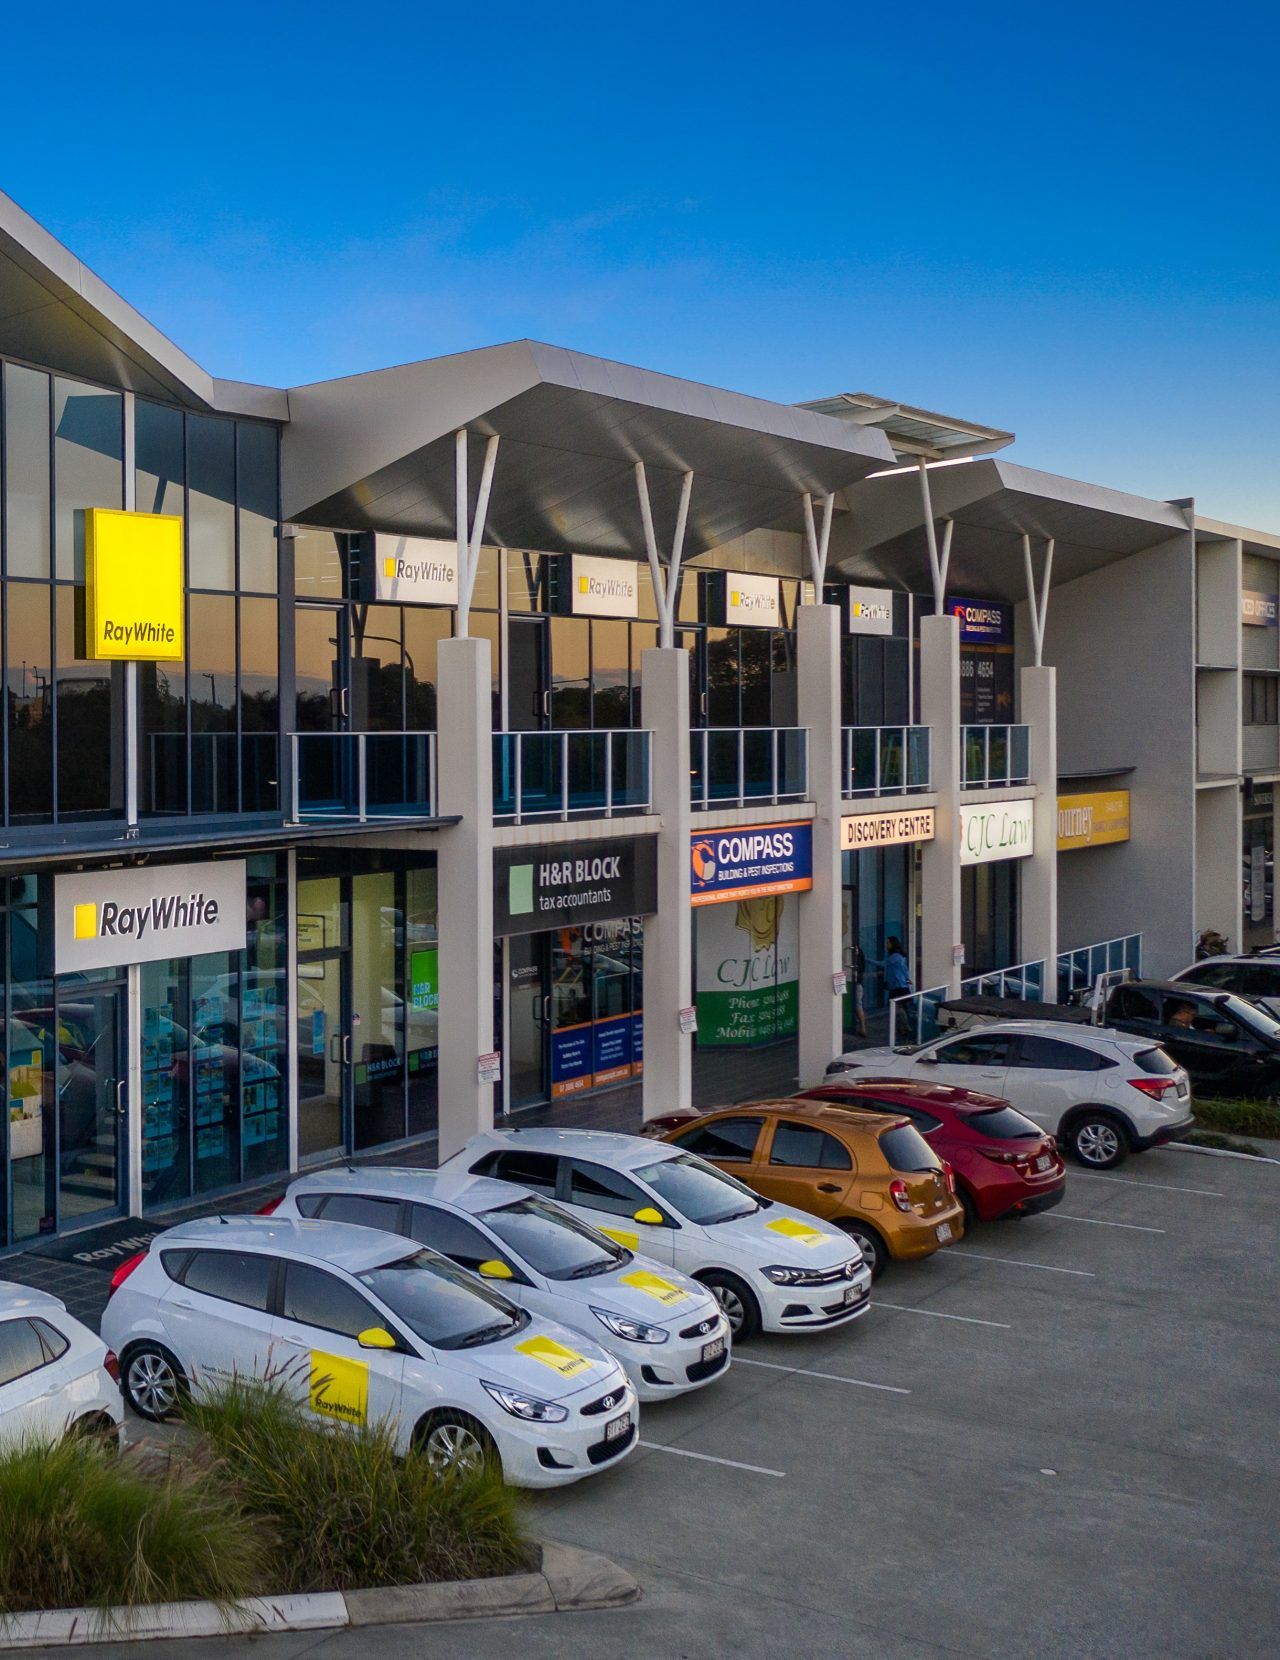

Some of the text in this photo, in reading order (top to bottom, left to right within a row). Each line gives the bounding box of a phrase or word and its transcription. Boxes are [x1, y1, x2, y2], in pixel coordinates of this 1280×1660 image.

[396, 559, 454, 583] RayWhite
[588, 577, 633, 598] RayWhite
[740, 591, 775, 611] RayWhite
[965, 607, 1002, 625] COMPASS
[103, 620, 175, 645] RayWhite
[848, 815, 931, 843] DISCOVERY CENTRE
[967, 813, 1031, 857] CJC Law
[1056, 801, 1094, 844] ourney
[718, 832, 794, 864] COMPASS
[540, 856, 620, 886] H&R BLOCK
[718, 867, 743, 881] BUILDING
[540, 887, 611, 911] tax accountants
[100, 893, 219, 940] RayWhite
[583, 916, 643, 942] COMPAS
[717, 957, 760, 987] CJC
[314, 1398, 361, 1418] RayWhite
